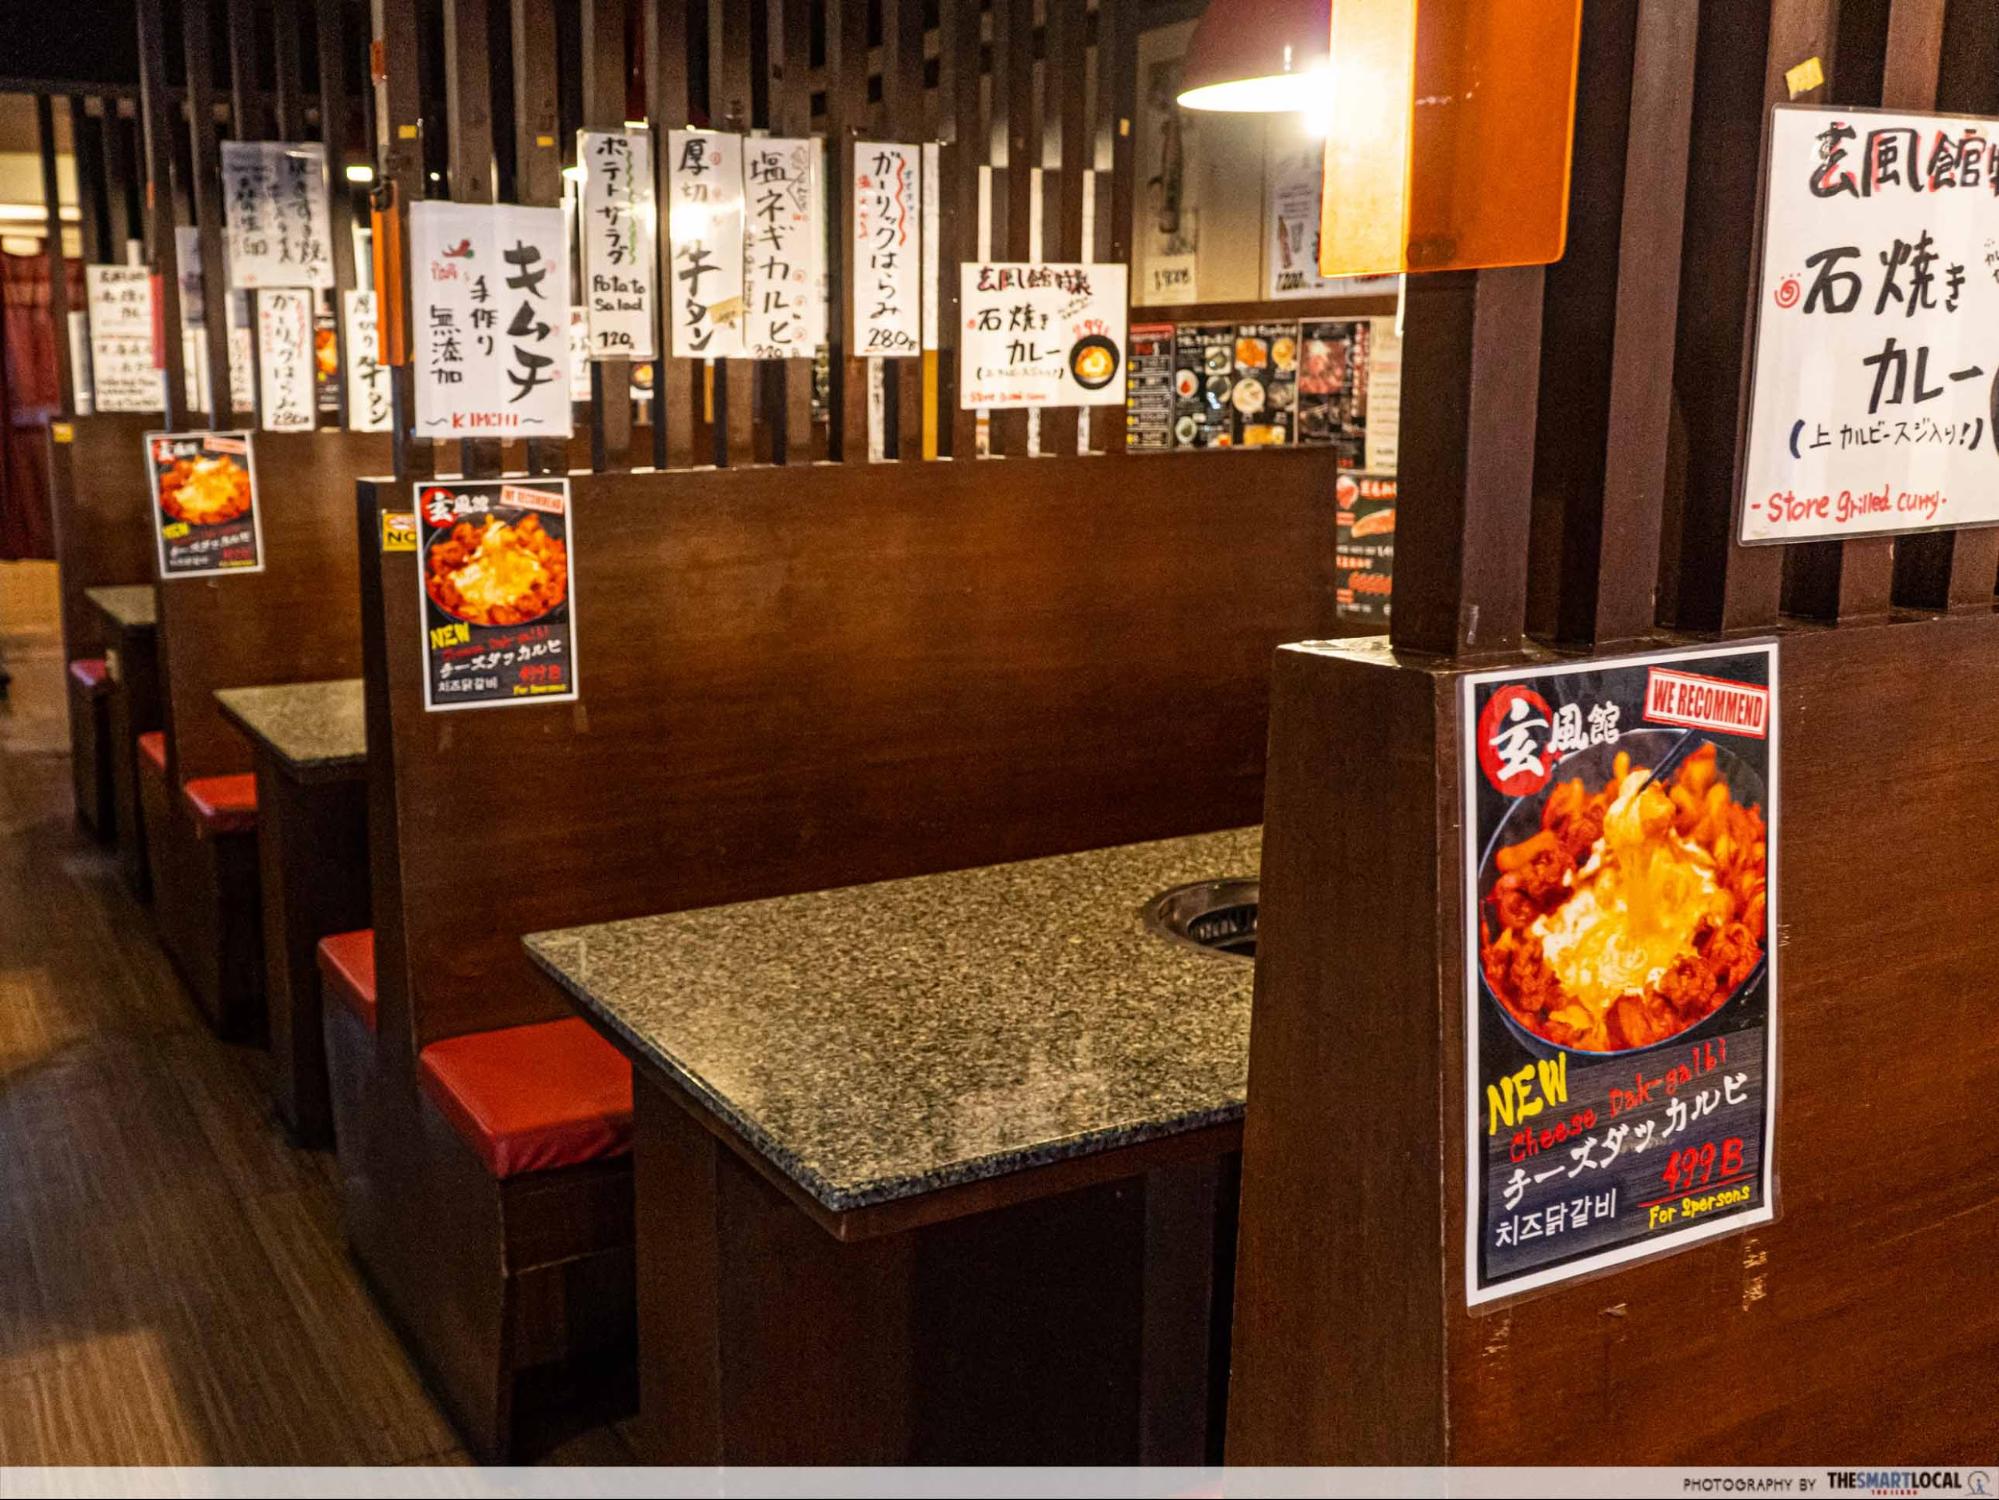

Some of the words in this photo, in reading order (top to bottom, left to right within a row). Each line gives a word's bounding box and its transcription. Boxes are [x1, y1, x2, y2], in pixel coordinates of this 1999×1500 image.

[593, 275, 646, 294] Potato
[1803, 230, 1966, 318] 石焼き
[470, 275, 499, 356] 手作り
[503, 240, 555, 403] キムチ
[594, 298, 644, 311] Salad
[430, 305, 464, 384] 無添加
[1005, 340, 1061, 365] カレー
[1863, 338, 1985, 415] カレー
[451, 412, 519, 428] KIMCHI
[1836, 484, 1891, 523] grilled
[430, 621, 471, 650] NEW
[1653, 678, 1674, 714] WE
[1677, 682, 1764, 728] RECOMMEND
[1489, 697, 1620, 782] 玄風館
[1486, 1051, 1569, 1136] NEW
[1502, 1072, 1748, 1211] チーズダッカルビ
[1509, 1108, 1598, 1163] Cheese
[1495, 1188, 1618, 1249] 치즈닭갈비
[1648, 1204, 1677, 1230] For
